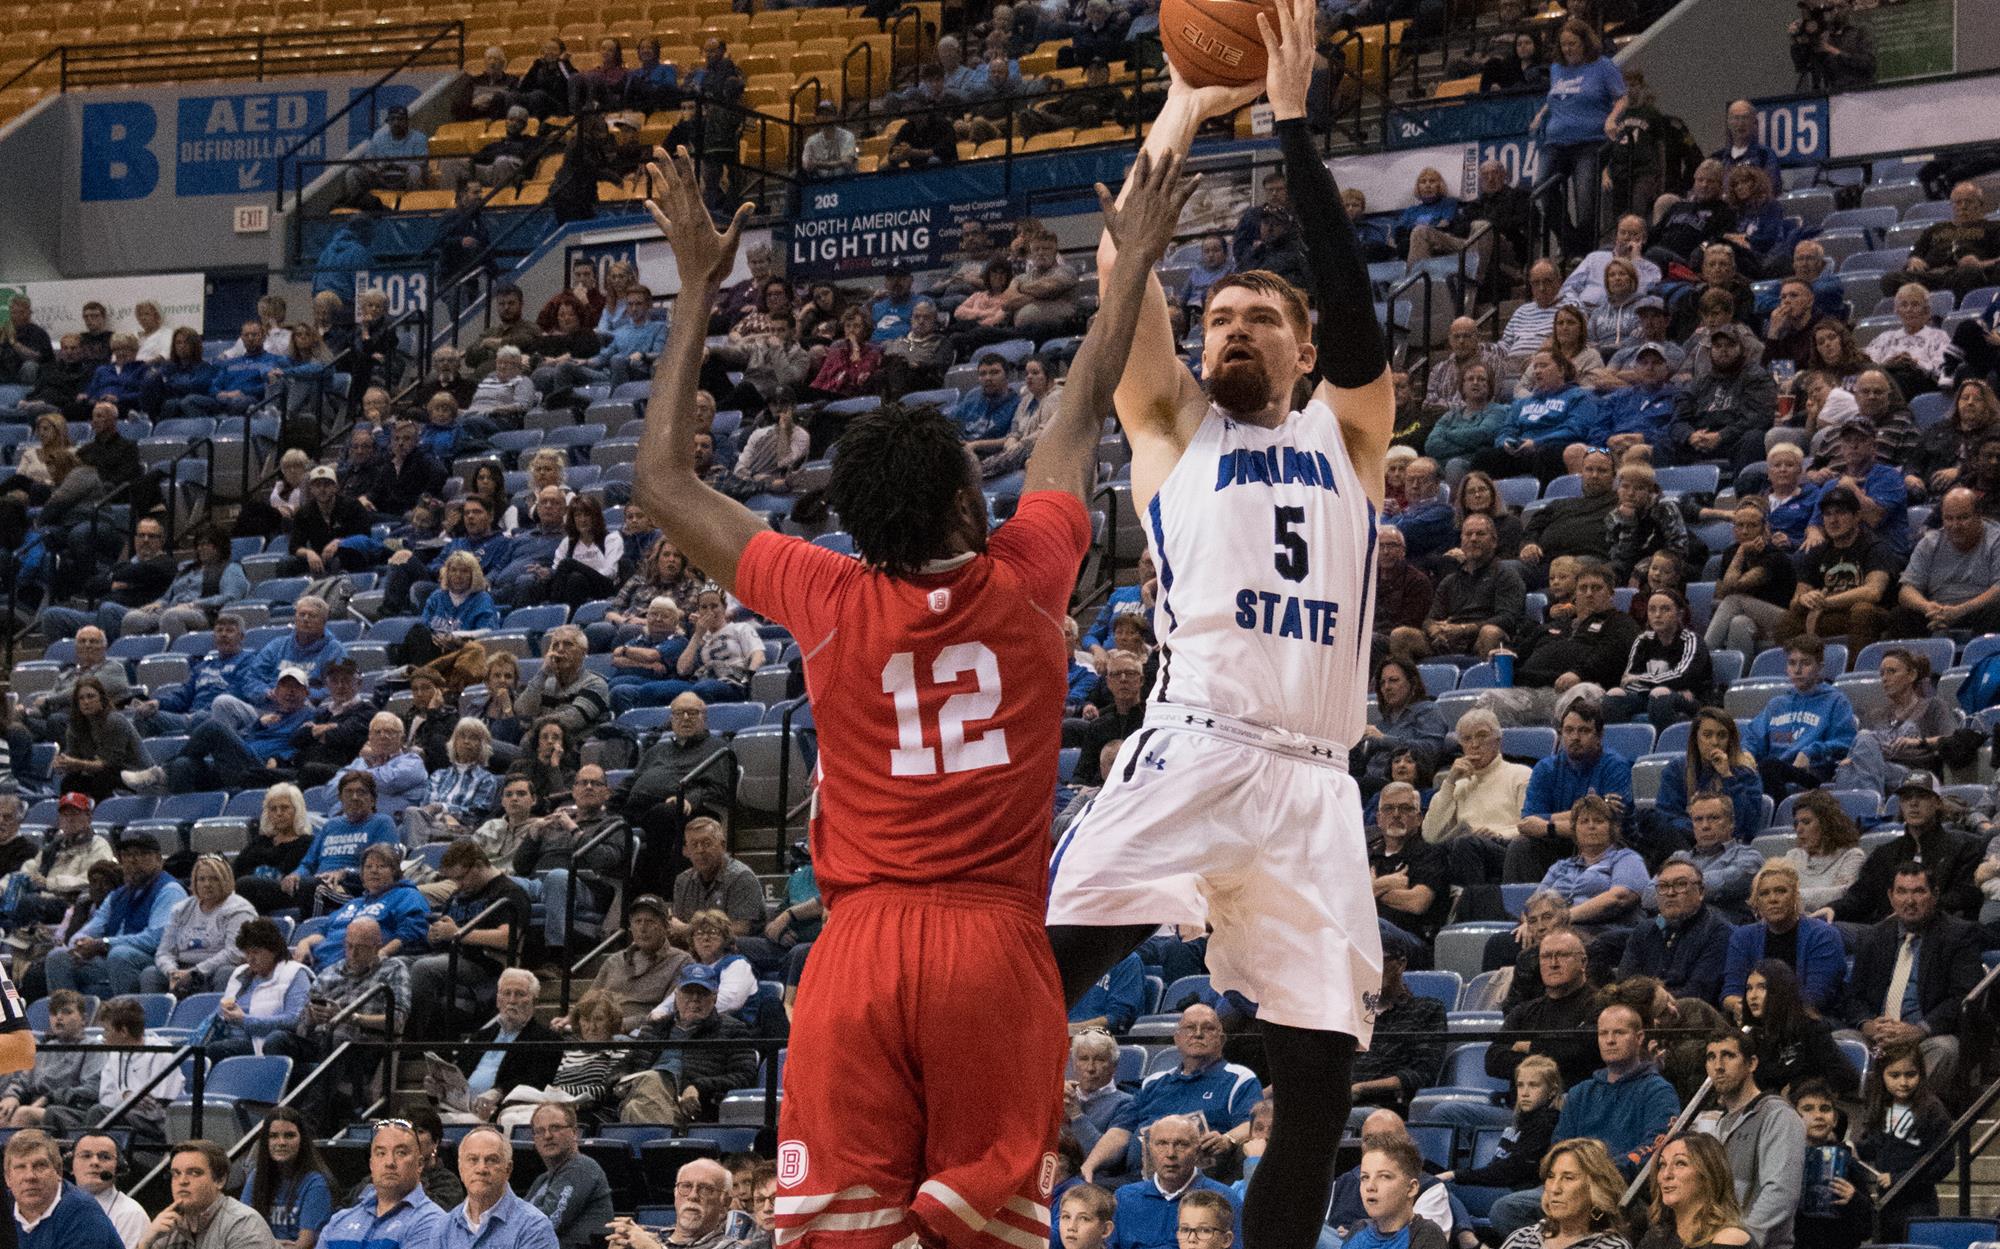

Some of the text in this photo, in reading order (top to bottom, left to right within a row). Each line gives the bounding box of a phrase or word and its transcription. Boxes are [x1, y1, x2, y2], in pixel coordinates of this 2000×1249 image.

[1182, 20, 1243, 66] ELITE
[205, 95, 308, 133] AED
[1757, 104, 1818, 158] 105
[80, 101, 160, 201] B
[1466, 147, 1477, 194] SECTION
[239, 209, 263, 228] EXIT
[795, 208, 931, 238] NORTH AMERICAN
[814, 193, 839, 209] 203
[794, 227, 930, 264] LIGHTING
[938, 227, 963, 238] Colleg
[1215, 445, 1340, 498] INDIANA
[1274, 504, 1310, 583] 5
[1235, 588, 1339, 646] STATE
[881, 640, 1011, 776] 12
[781, 1149, 801, 1179] B
